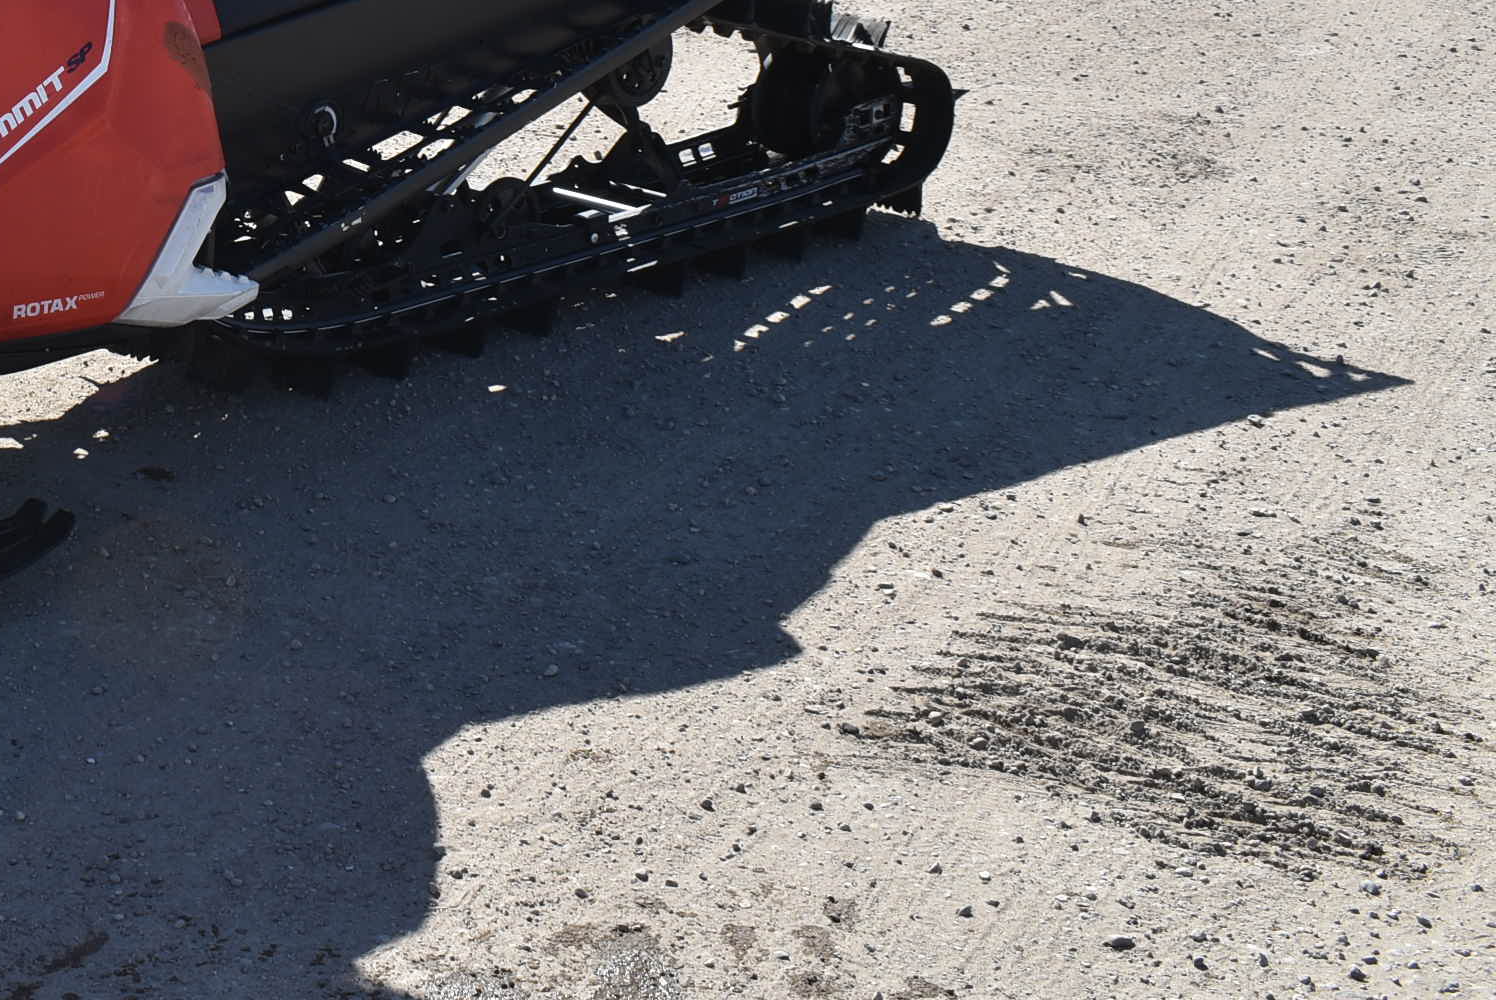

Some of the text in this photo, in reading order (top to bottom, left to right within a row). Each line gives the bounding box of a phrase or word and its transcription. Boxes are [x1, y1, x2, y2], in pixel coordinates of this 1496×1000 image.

[66, 42, 93, 74] SP
[13, 291, 105, 319] ROTAX POWER
